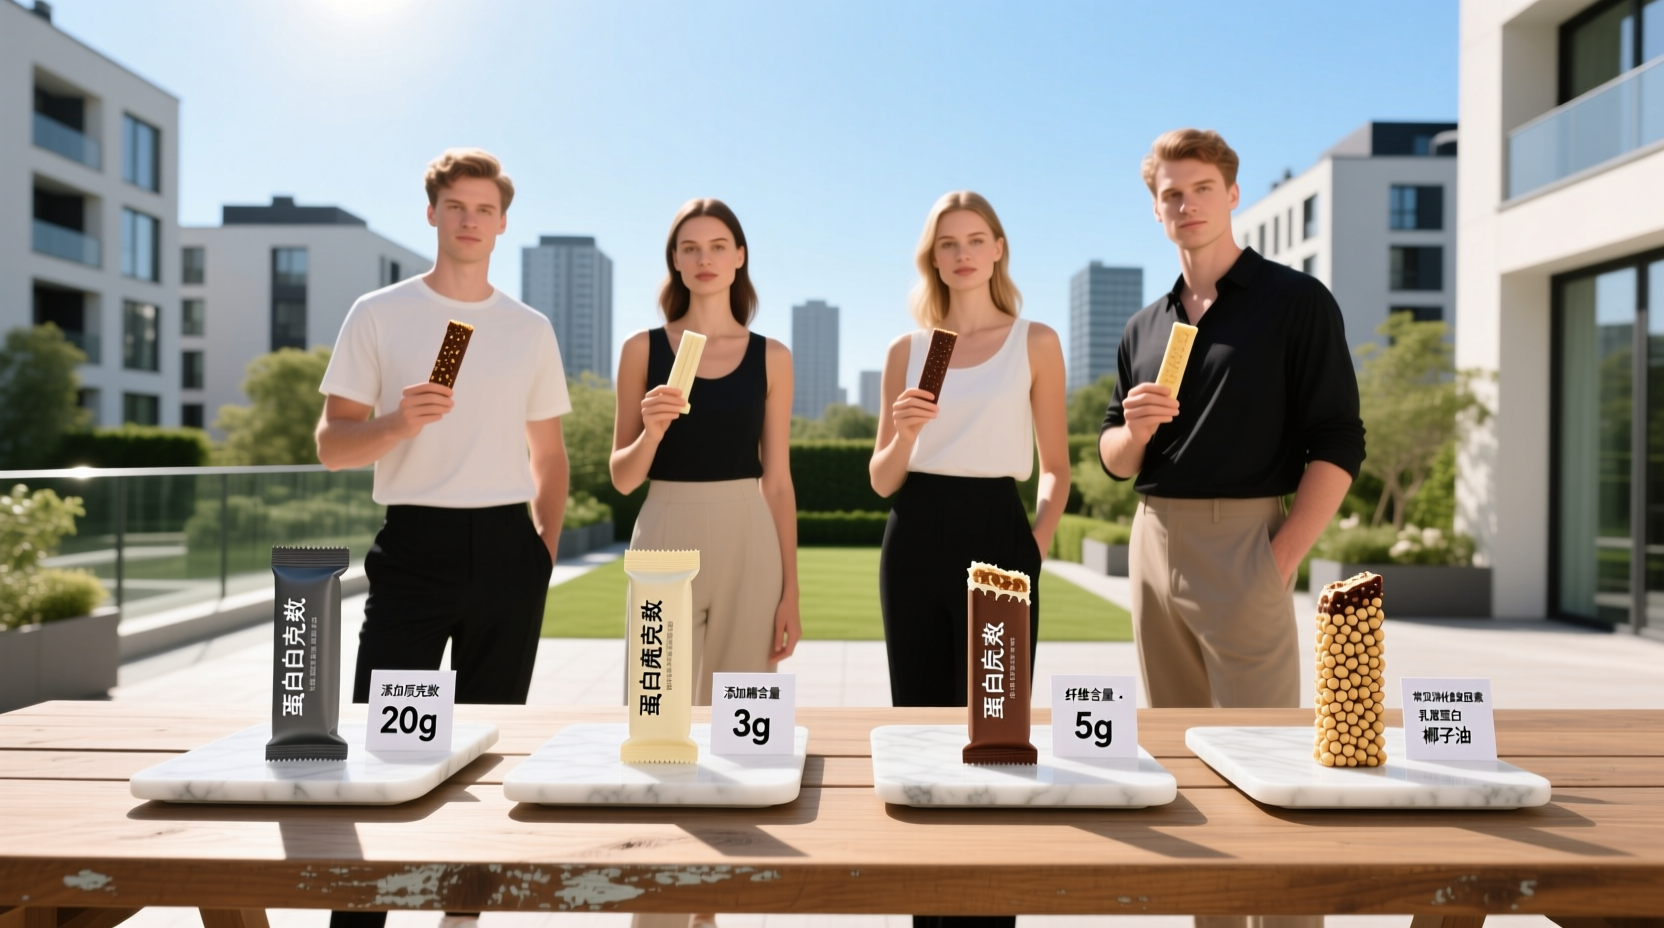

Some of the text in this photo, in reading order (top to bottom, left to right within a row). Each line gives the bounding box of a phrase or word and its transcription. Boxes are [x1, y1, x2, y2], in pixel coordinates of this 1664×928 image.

[380, 706, 437, 742] 20g
[733, 709, 770, 745] 3g
[1075, 711, 1112, 748] 5g
